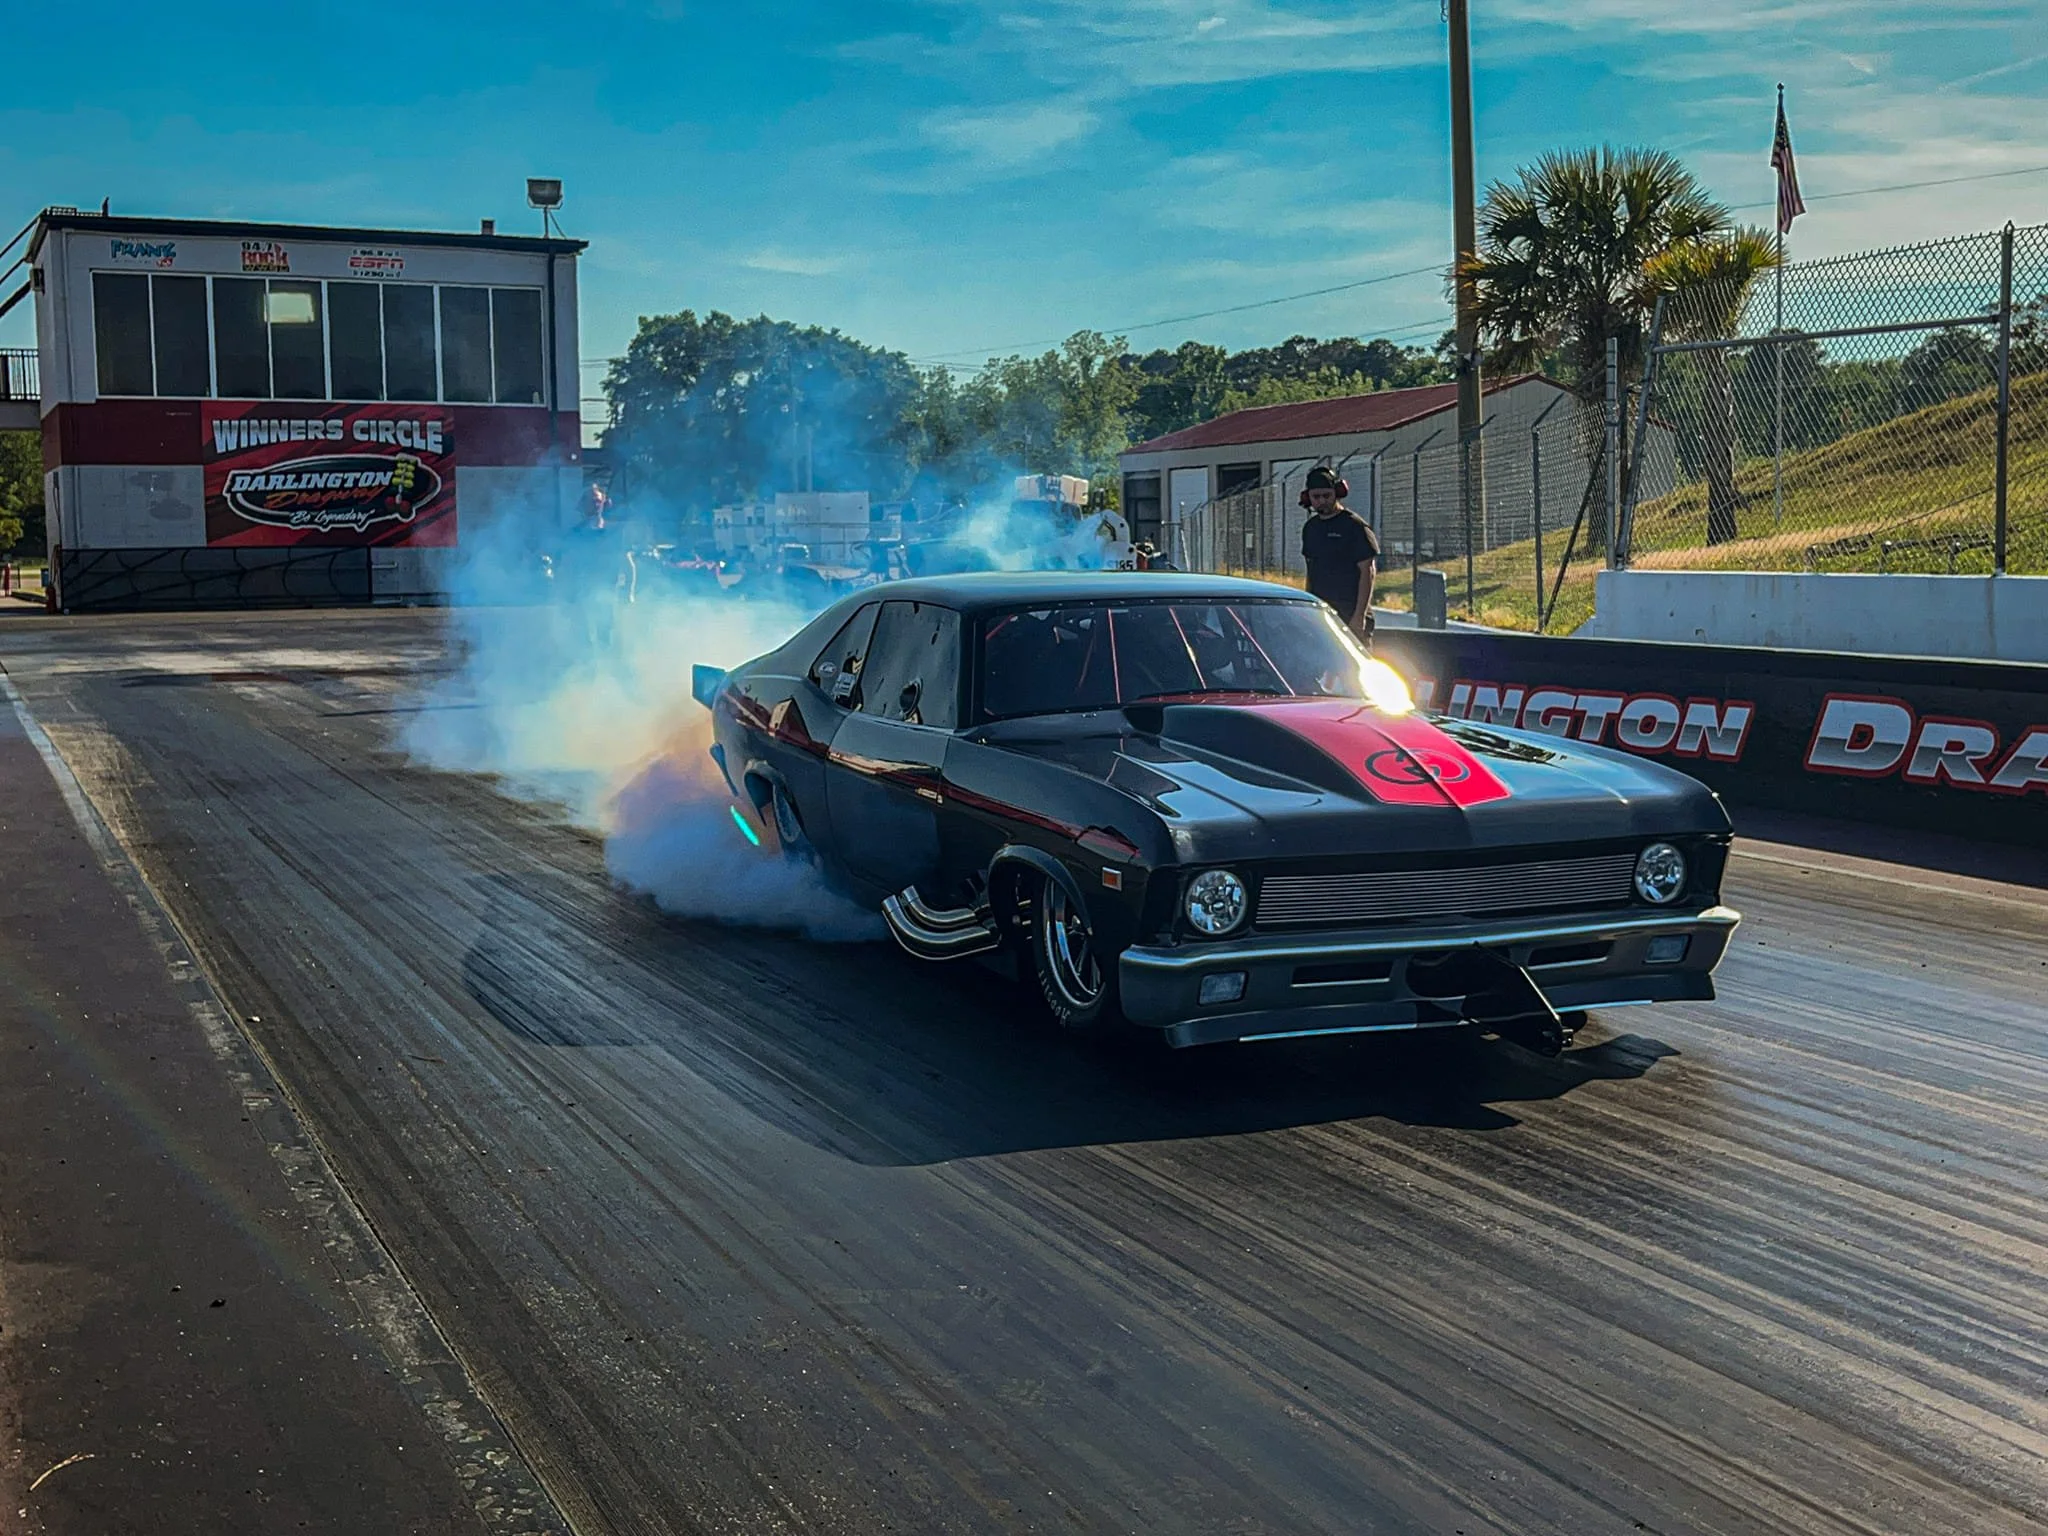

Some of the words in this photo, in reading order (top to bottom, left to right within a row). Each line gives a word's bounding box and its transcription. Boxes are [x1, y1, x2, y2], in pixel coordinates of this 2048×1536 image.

[111, 239, 176, 259] FRANK
[241, 243, 288, 265] ROCK
[349, 256, 404, 270] ESPN
[212, 419, 344, 455] WINNERS
[352, 420, 443, 455] CIRCLE
[231, 471, 394, 493] DARLINGTON
